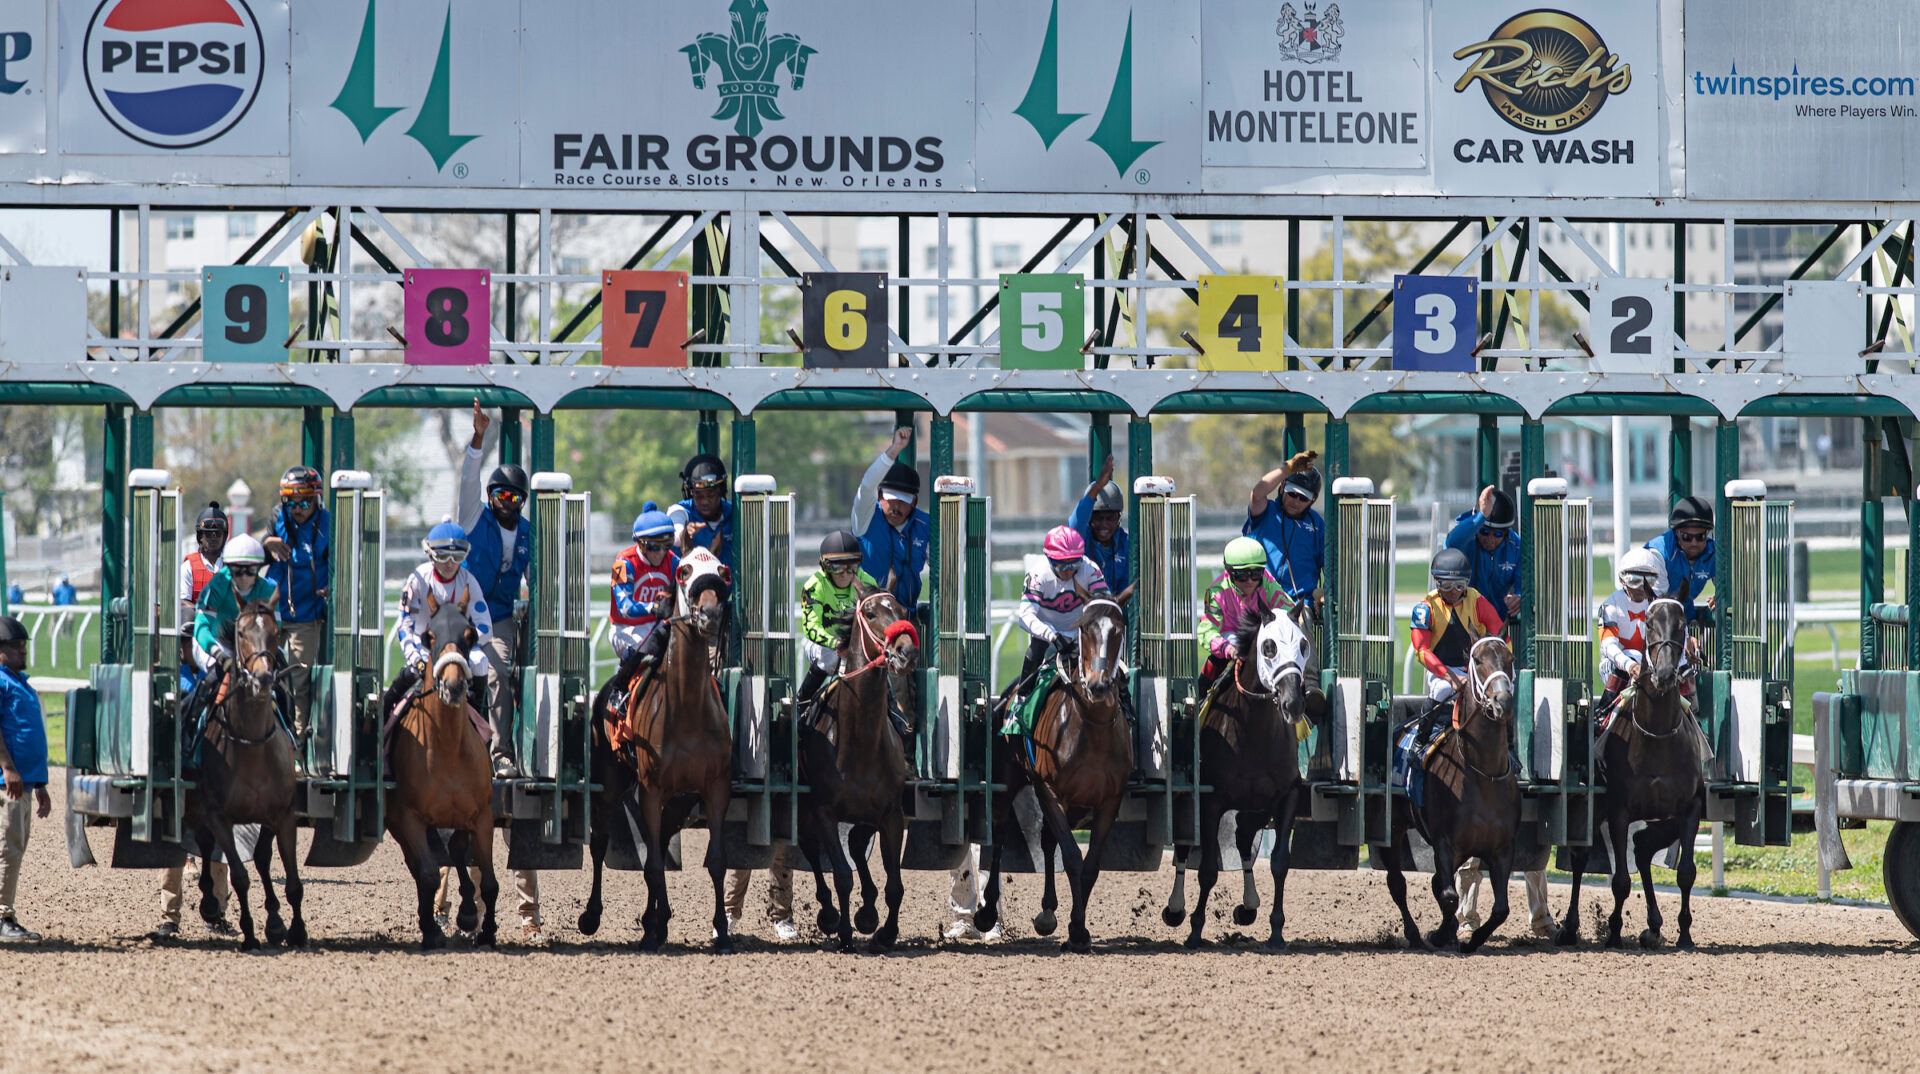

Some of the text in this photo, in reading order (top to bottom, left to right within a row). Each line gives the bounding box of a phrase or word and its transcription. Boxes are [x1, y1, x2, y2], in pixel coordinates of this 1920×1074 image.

[102, 41, 246, 74] PEPSI
[1453, 38, 1632, 95] Rich's
[1264, 70, 1363, 102] HOTEL
[1694, 58, 1915, 101] twinspires.com
[1209, 110, 1418, 144] MONTELEONE
[1501, 101, 1592, 128] WASH DAT!
[1796, 105, 1918, 120] Where Players Win.
[554, 133, 944, 173] FAIR GROUNDS
[1454, 139, 1634, 164] CAR WASH
[554, 173, 944, 188] Race Course & Slots New Orleans
[225, 284, 267, 344] 9
[425, 287, 469, 347] 8
[625, 290, 666, 348] 7
[824, 290, 867, 350] 6
[1021, 292, 1063, 351] 5
[1218, 294, 1262, 352] 4
[1414, 294, 1457, 354] 3
[1610, 296, 1653, 354] 2
[615, 566, 623, 581] 7
[1415, 608, 1427, 625] 3
